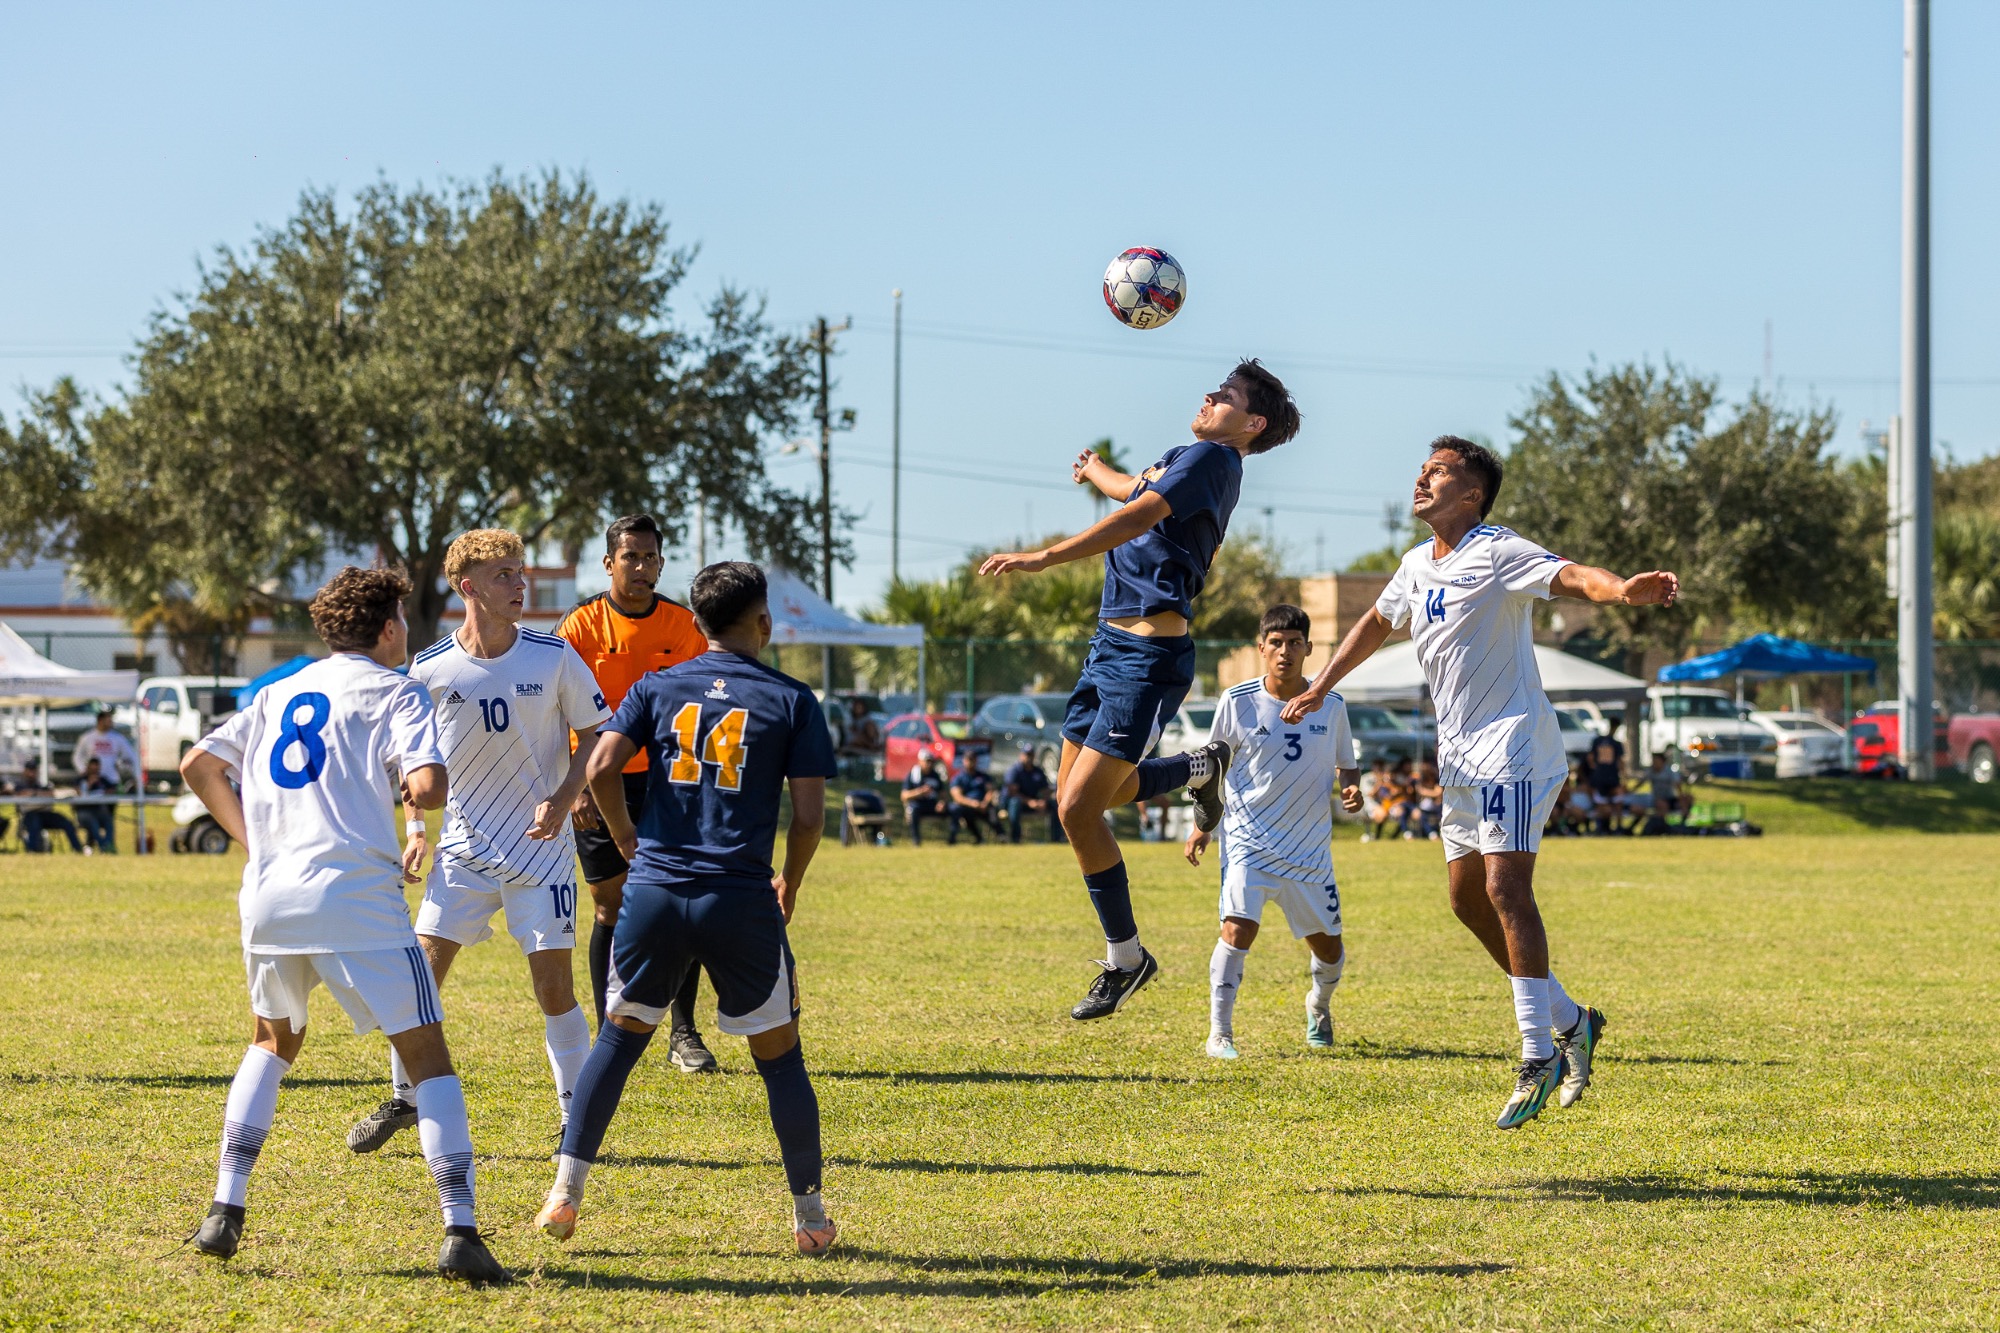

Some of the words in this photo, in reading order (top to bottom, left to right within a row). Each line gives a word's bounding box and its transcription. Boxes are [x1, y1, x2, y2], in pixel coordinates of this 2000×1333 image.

[1426, 588, 1446, 623] 14
[516, 683, 543, 692] BLINN
[479, 697, 510, 733] 10
[270, 692, 331, 789] 8
[668, 702, 749, 792] 14
[1283, 733, 1303, 762] 3
[1481, 784, 1506, 822] 14
[549, 884, 573, 919] 10
[1325, 885, 1339, 912] 3
